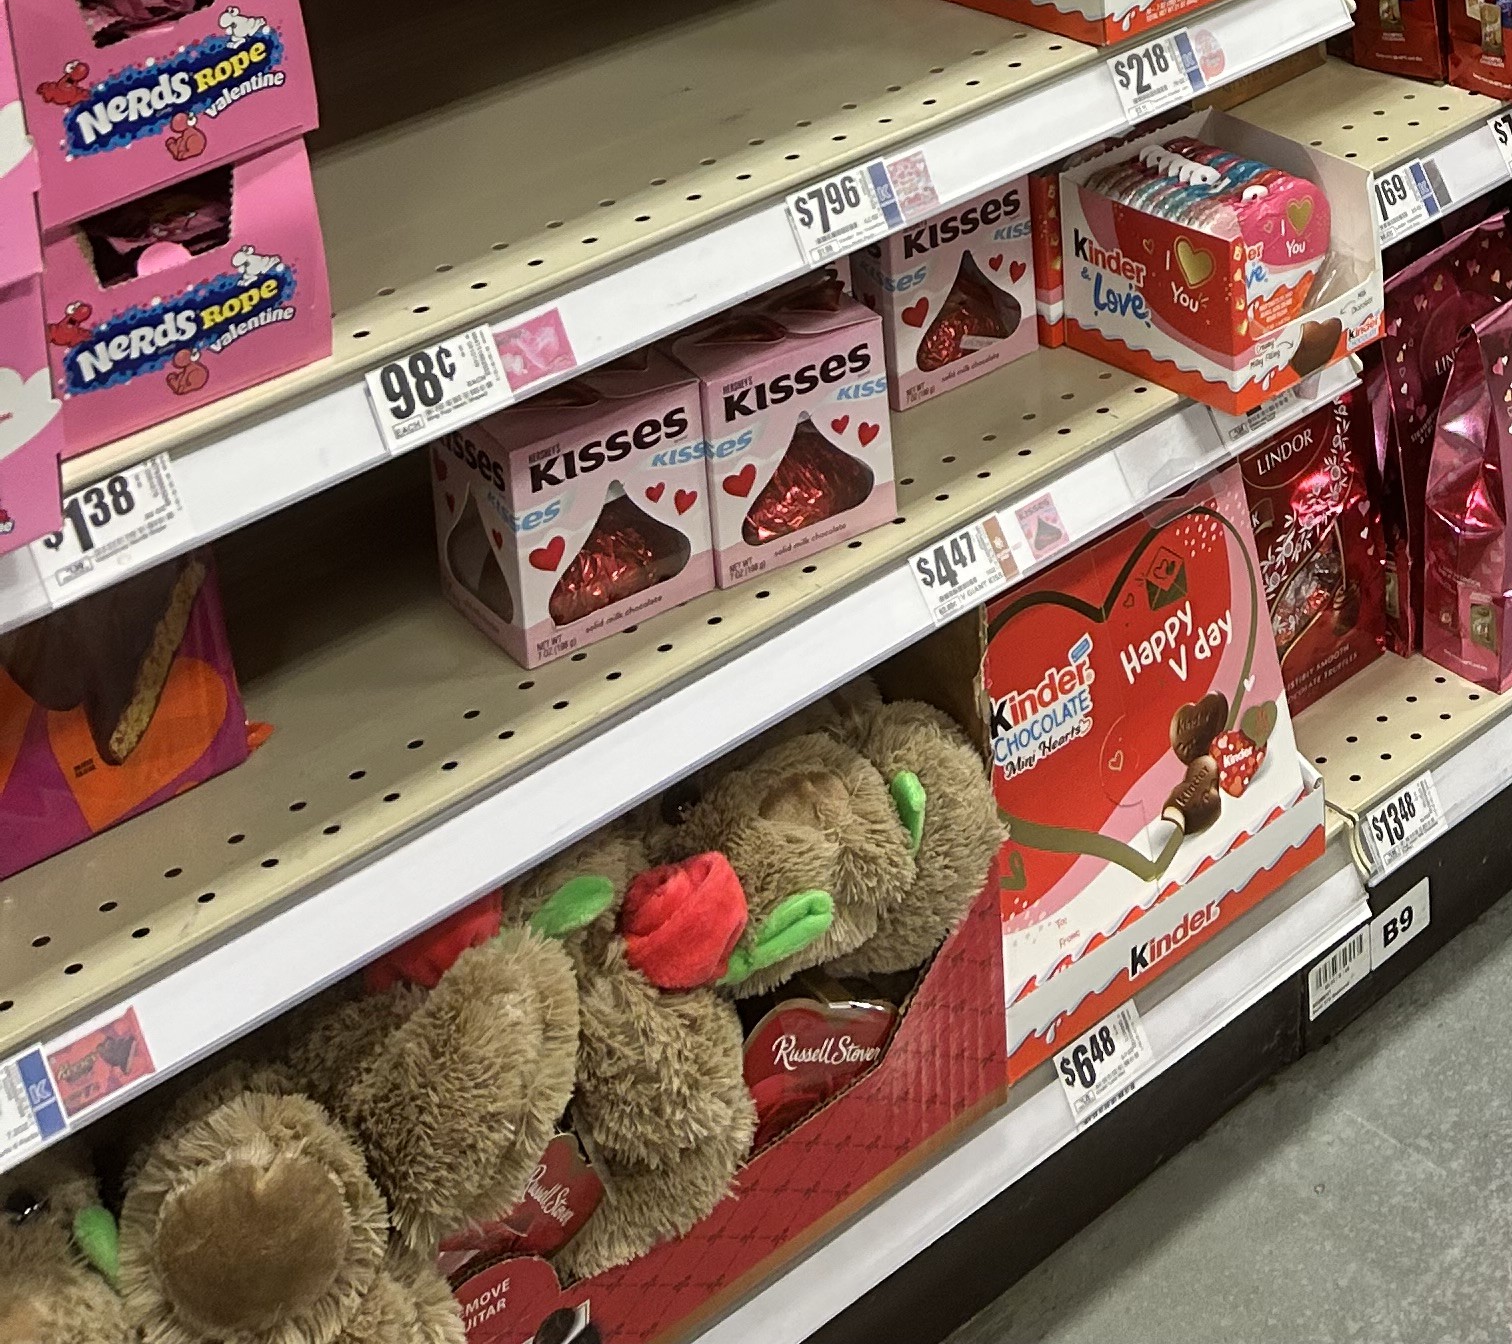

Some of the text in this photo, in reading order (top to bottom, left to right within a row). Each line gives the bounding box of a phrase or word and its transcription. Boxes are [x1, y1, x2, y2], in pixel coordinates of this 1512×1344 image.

[205, 68, 285, 120] valentine
[1286, 240, 1305, 256] You
[1093, 273, 1147, 320] Love
[1171, 282, 1199, 312] You
[209, 305, 295, 354] valentine
[1118, 601, 1192, 684] Happy
[1165, 609, 1234, 682] V day
[992, 690, 1091, 766] CHOCOLATE
[1002, 721, 1080, 781] Mini Hearts
[1381, 904, 1414, 949] B9
[772, 1035, 882, 1070] Russell Stover
